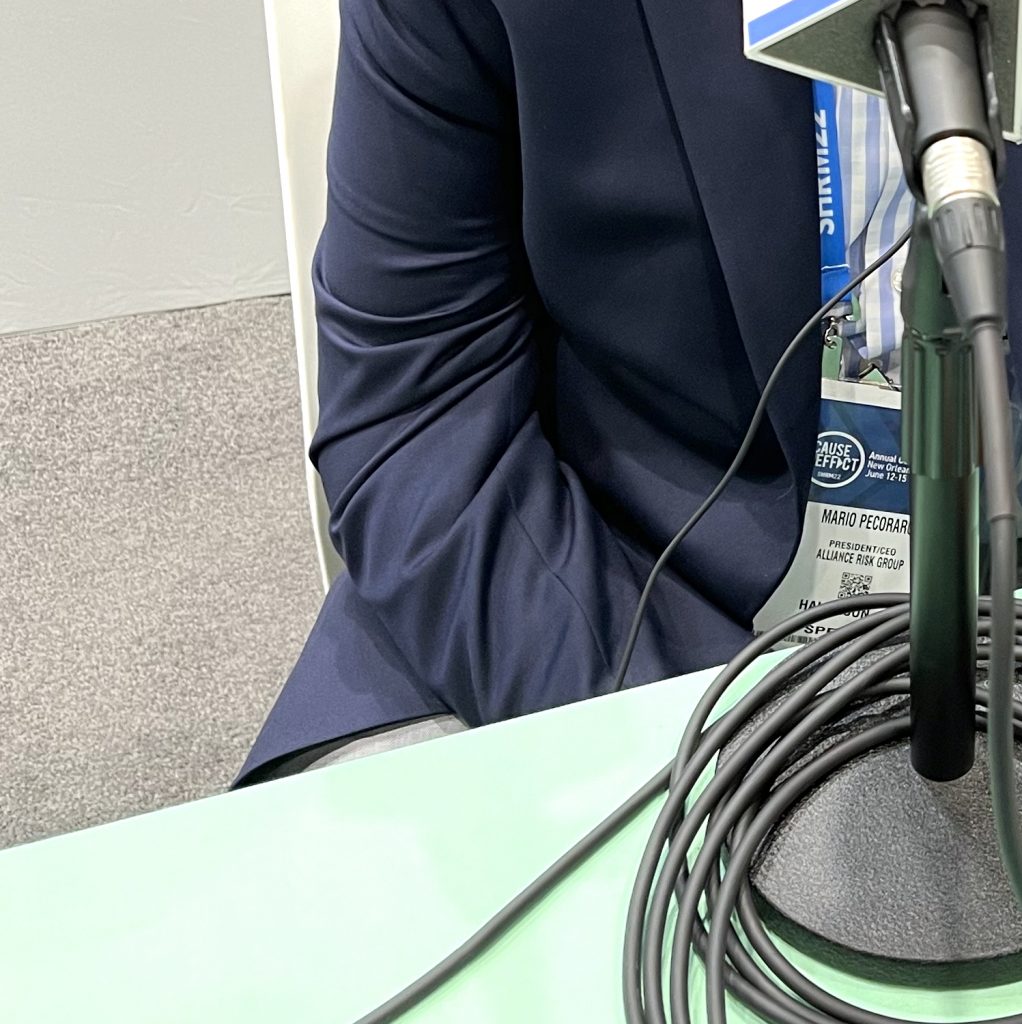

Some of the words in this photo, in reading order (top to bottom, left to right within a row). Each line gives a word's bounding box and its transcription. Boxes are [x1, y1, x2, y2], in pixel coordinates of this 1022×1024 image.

[868, 451, 897, 463] Annual
[867, 460, 885, 470] New
[865, 470, 884, 480] June
[886, 472, 907, 483] 12-15
[821, 509, 857, 528] MARIO
[829, 540, 897, 556] PRESIDENT/CEO
[816, 548, 855, 564] ALLIANCE
[856, 553, 875, 566] RISK
[877, 557, 905, 570] GROUP
